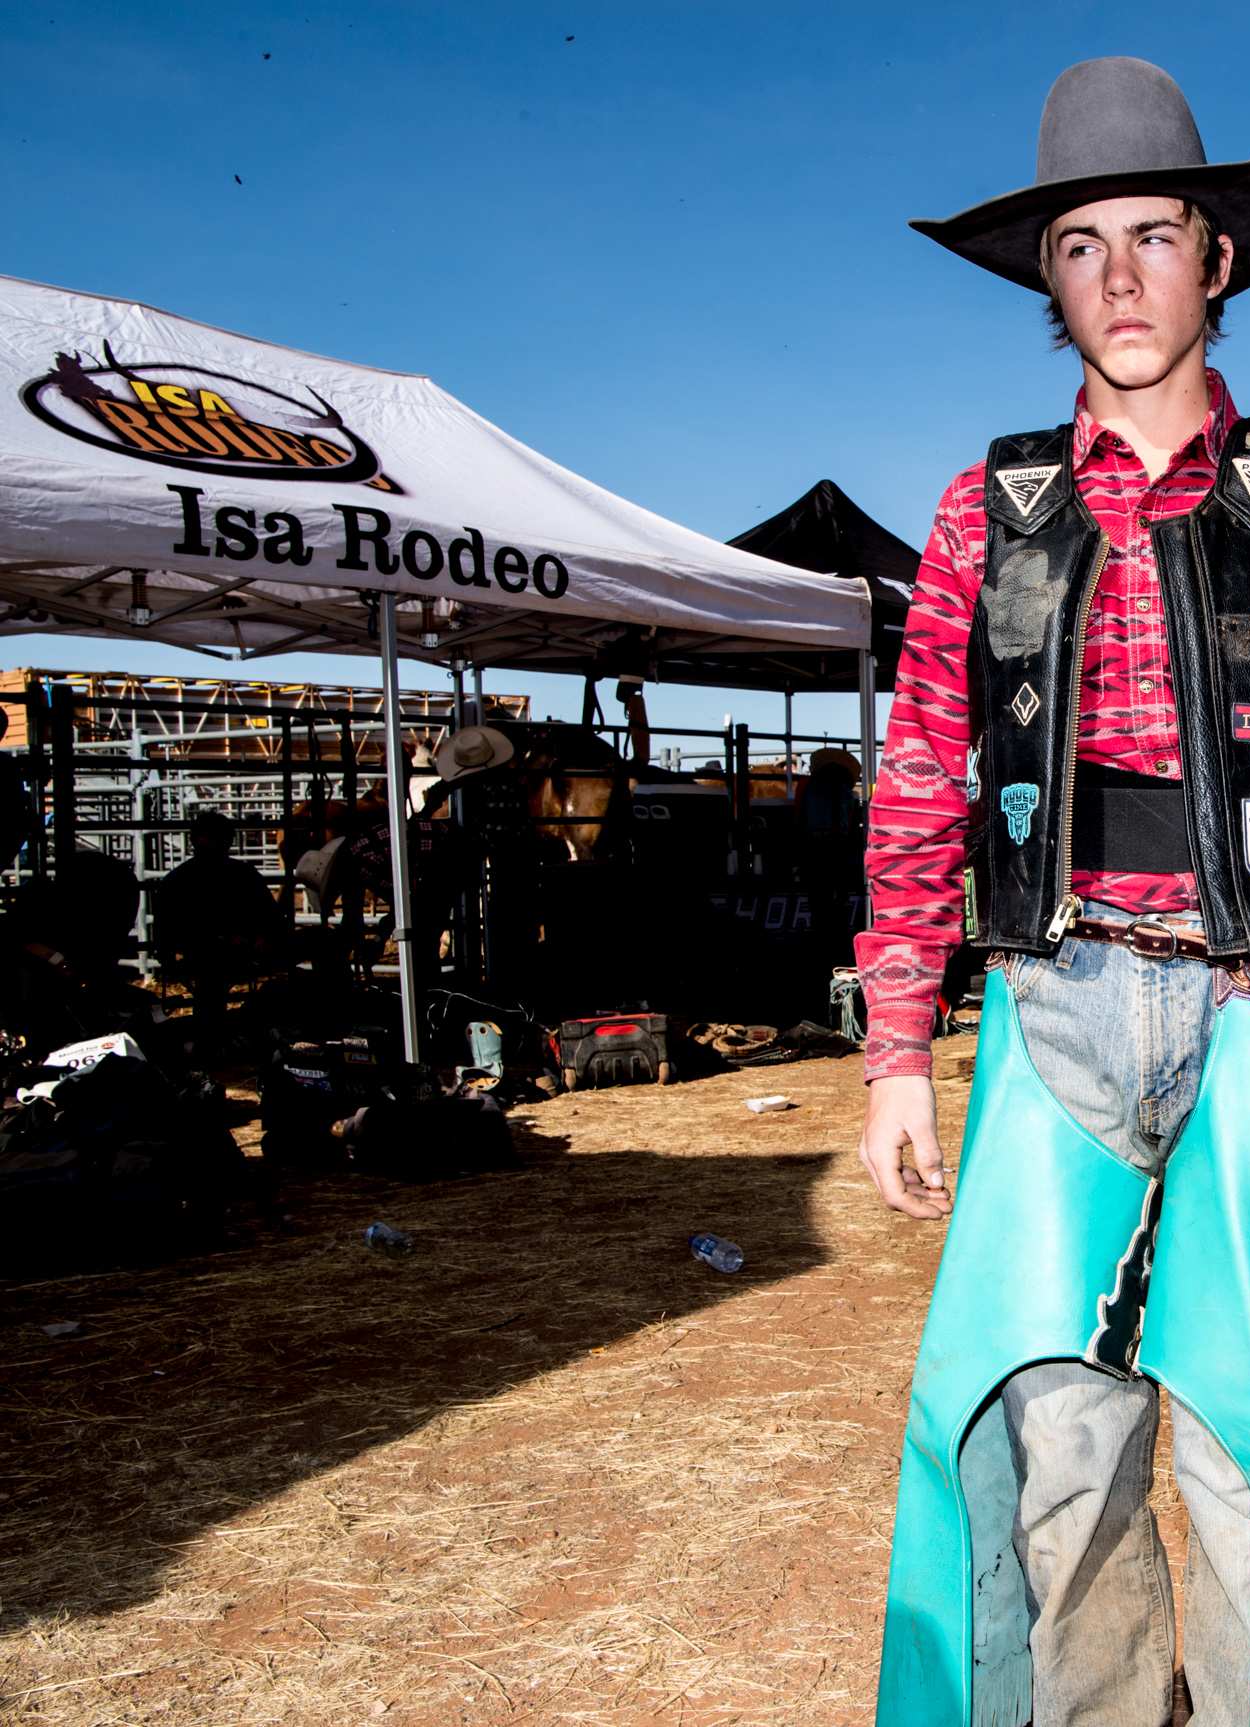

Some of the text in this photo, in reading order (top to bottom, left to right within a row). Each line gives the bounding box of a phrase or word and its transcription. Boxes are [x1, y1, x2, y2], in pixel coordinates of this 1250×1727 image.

[129, 381, 246, 424] ISA
[99, 399, 351, 468] RODEO
[1004, 470, 1051, 481] PHOENIX
[166, 483, 569, 599] Isa Rodeo
